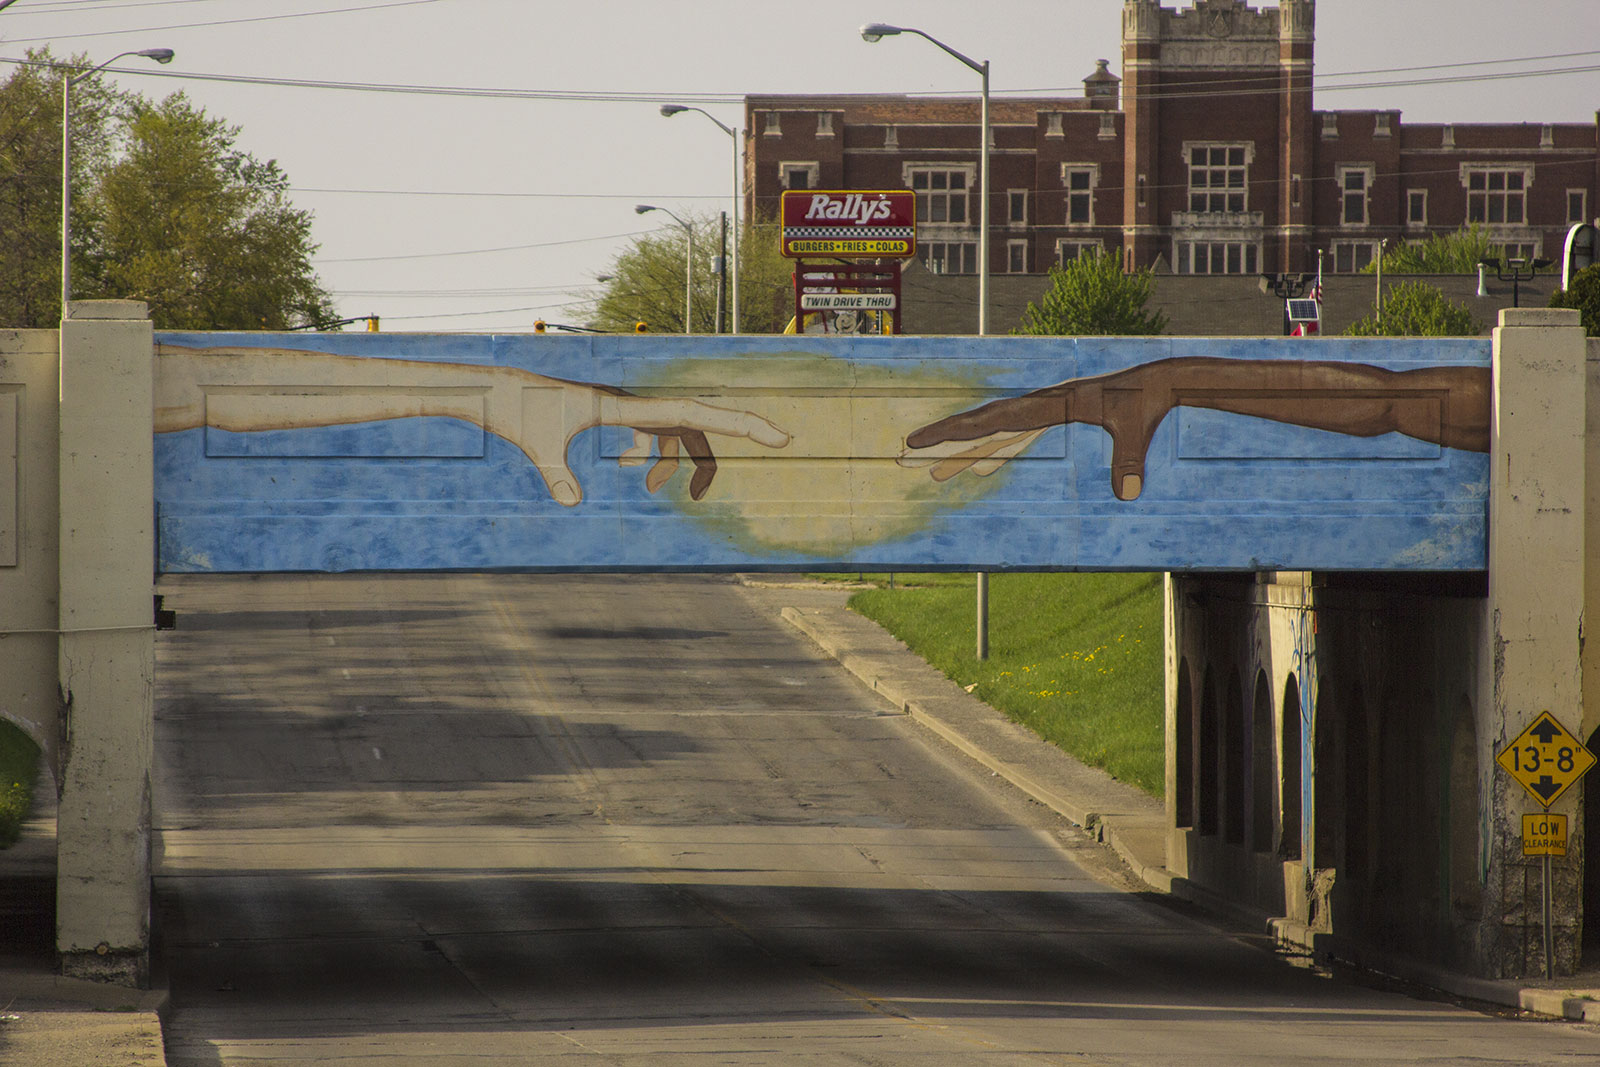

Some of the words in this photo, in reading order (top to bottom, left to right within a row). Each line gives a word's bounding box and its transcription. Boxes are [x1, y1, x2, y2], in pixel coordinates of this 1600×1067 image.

[804, 193, 892, 224] Rally's
[793, 241, 835, 252] BURGERS
[842, 241, 868, 252] FRIES
[875, 241, 905, 252] COLAS
[806, 297, 830, 307] TWIN
[833, 297, 863, 307] DRIVE
[866, 297, 892, 307] THRU
[1531, 822, 1560, 836] LOW
[1523, 839, 1566, 849] CLEARANCE
